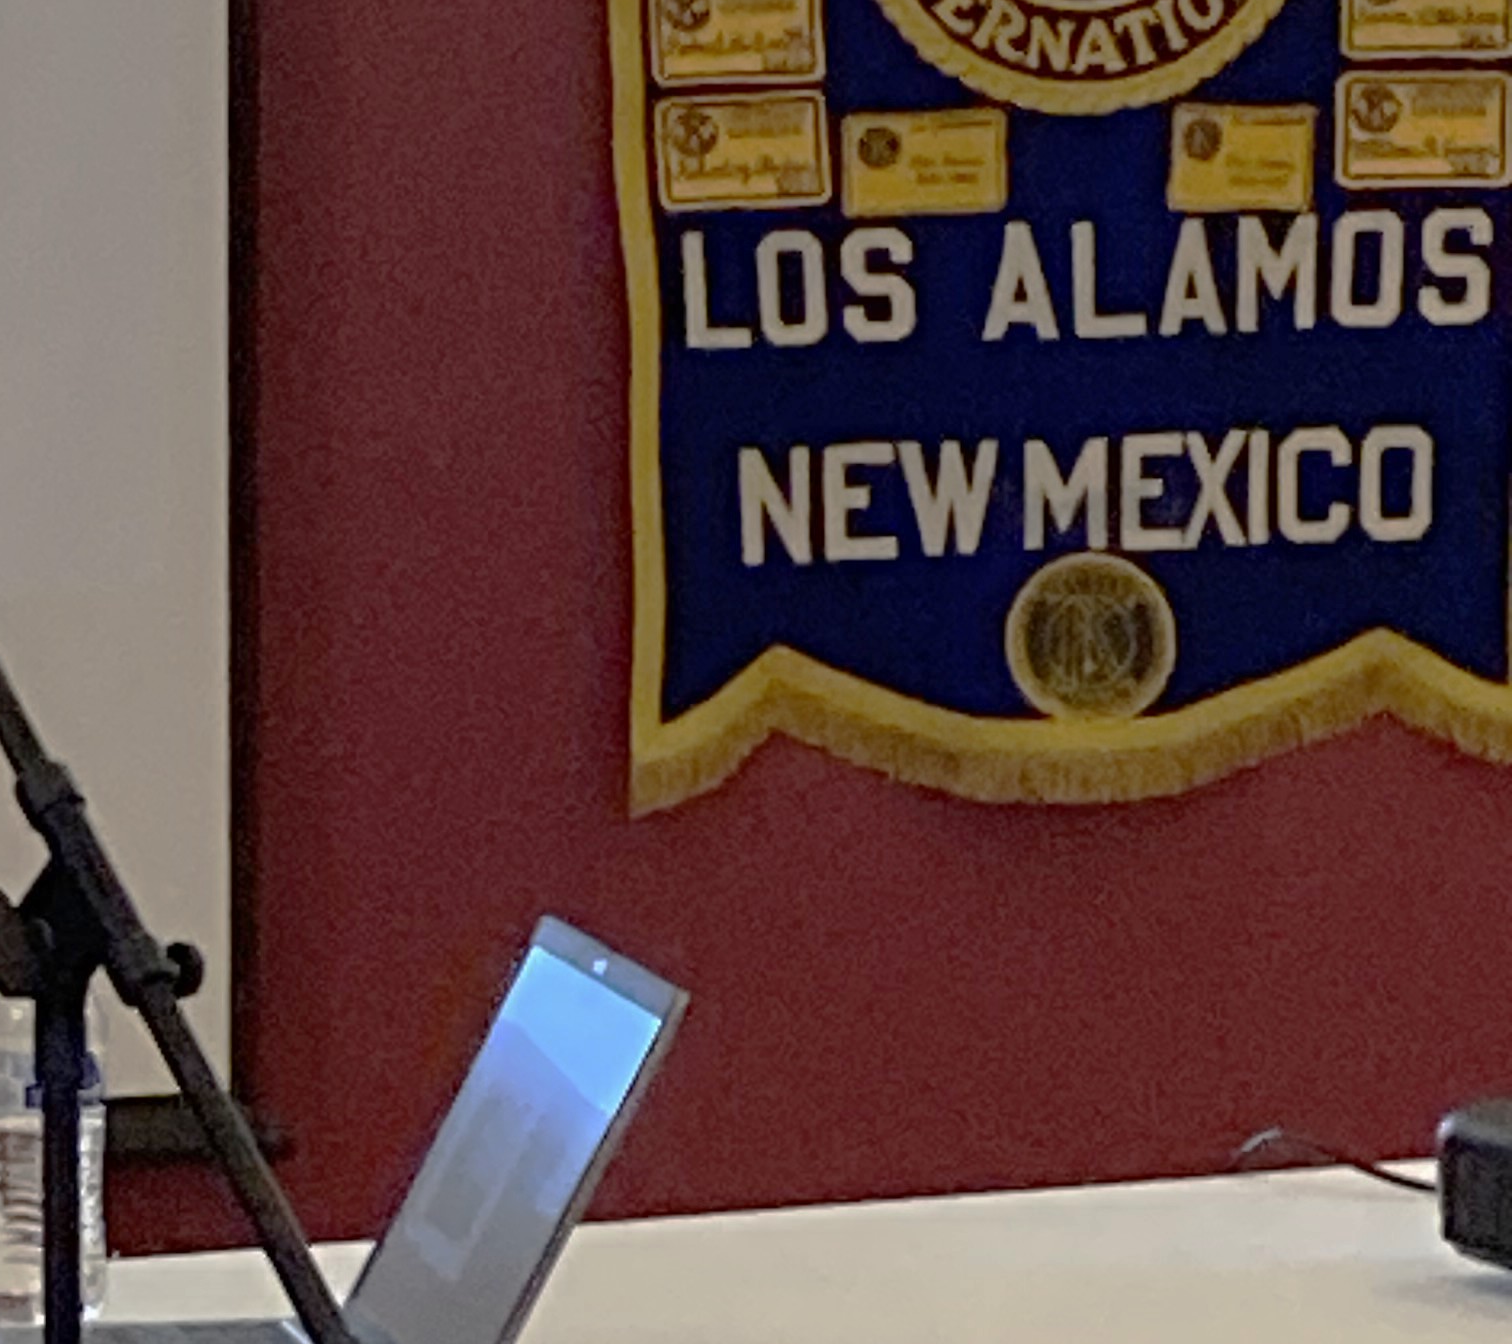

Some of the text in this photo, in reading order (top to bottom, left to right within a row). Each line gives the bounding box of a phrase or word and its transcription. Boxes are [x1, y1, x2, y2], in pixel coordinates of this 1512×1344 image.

[681, 207, 1495, 350] LOS ALAMOS
[737, 424, 1435, 568] NEW MEXICO
